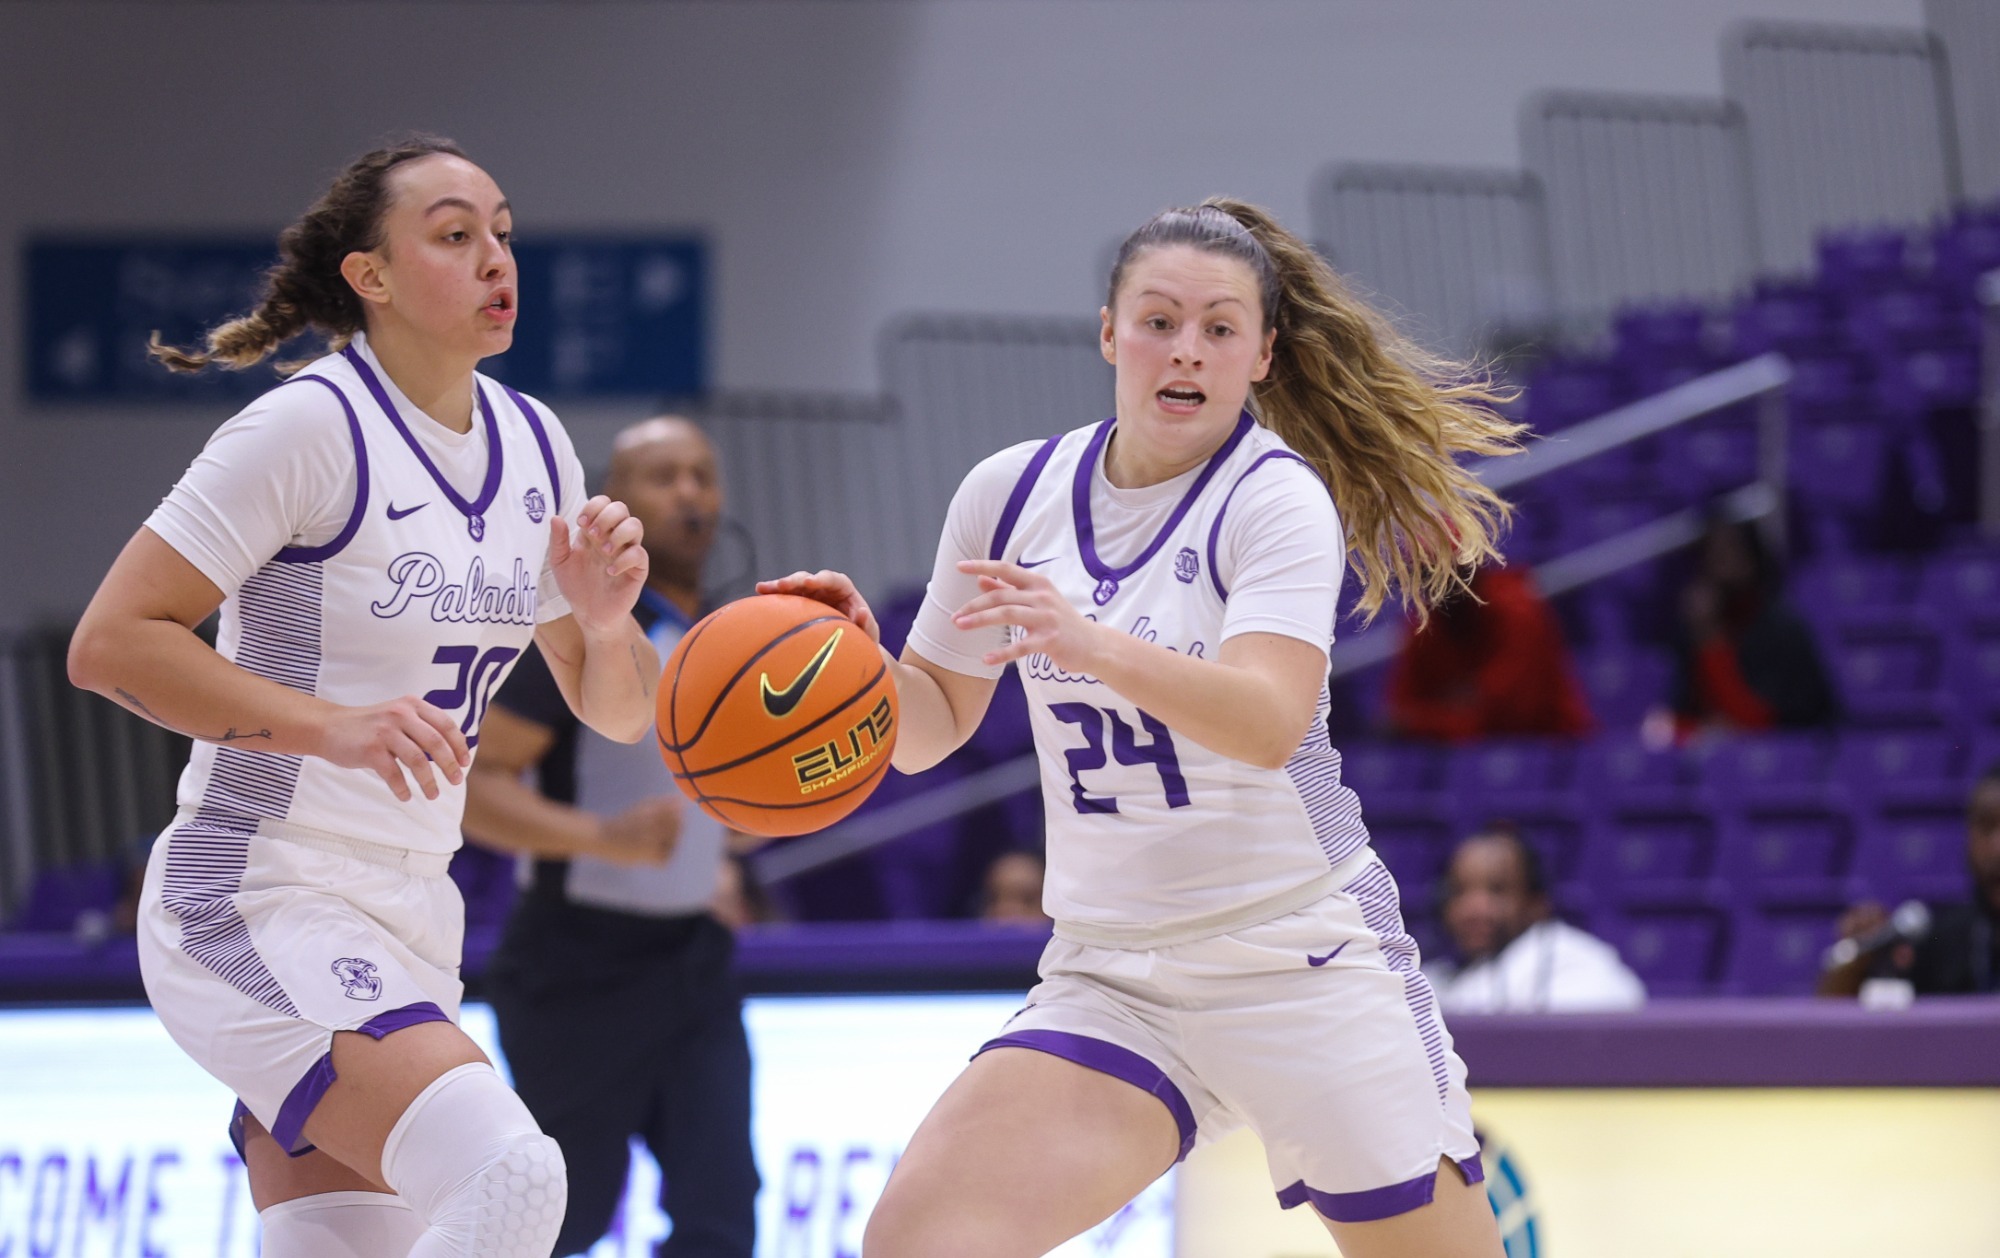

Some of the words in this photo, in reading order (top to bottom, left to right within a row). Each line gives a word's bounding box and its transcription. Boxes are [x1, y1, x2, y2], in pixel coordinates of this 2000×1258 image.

[792, 694, 893, 786] ELITE
[800, 726, 893, 794] CHAMPION
[1047, 702, 1192, 813] 24
